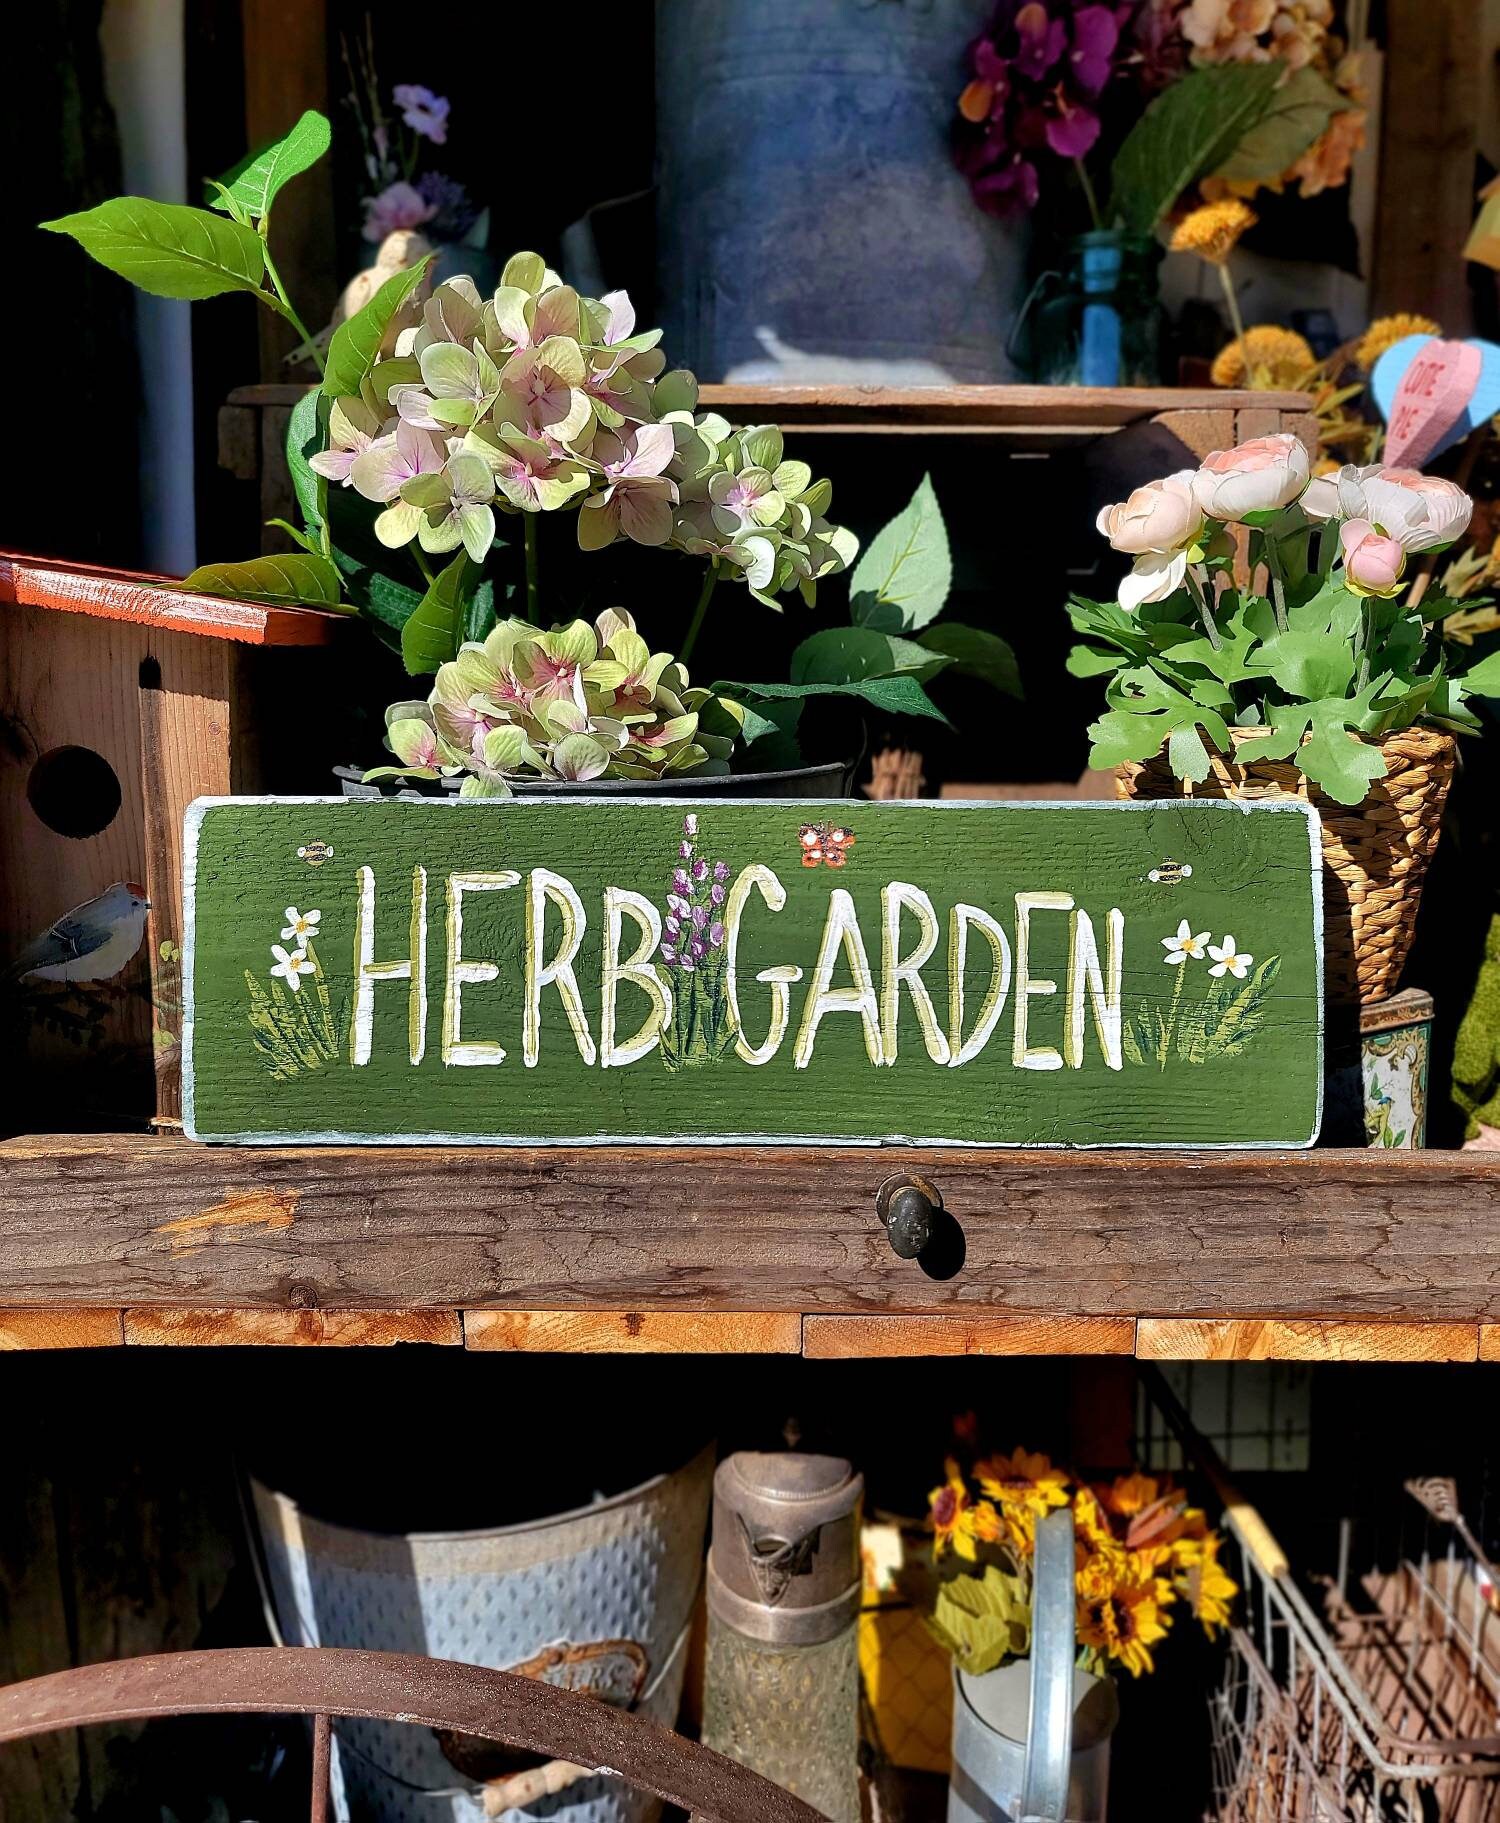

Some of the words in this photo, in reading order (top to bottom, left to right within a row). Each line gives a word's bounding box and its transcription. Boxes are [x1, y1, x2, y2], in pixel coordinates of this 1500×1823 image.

[1390, 405, 1420, 440] PIE
[349, 863, 673, 1069] HERB
[723, 864, 1125, 1071] GARDEN
